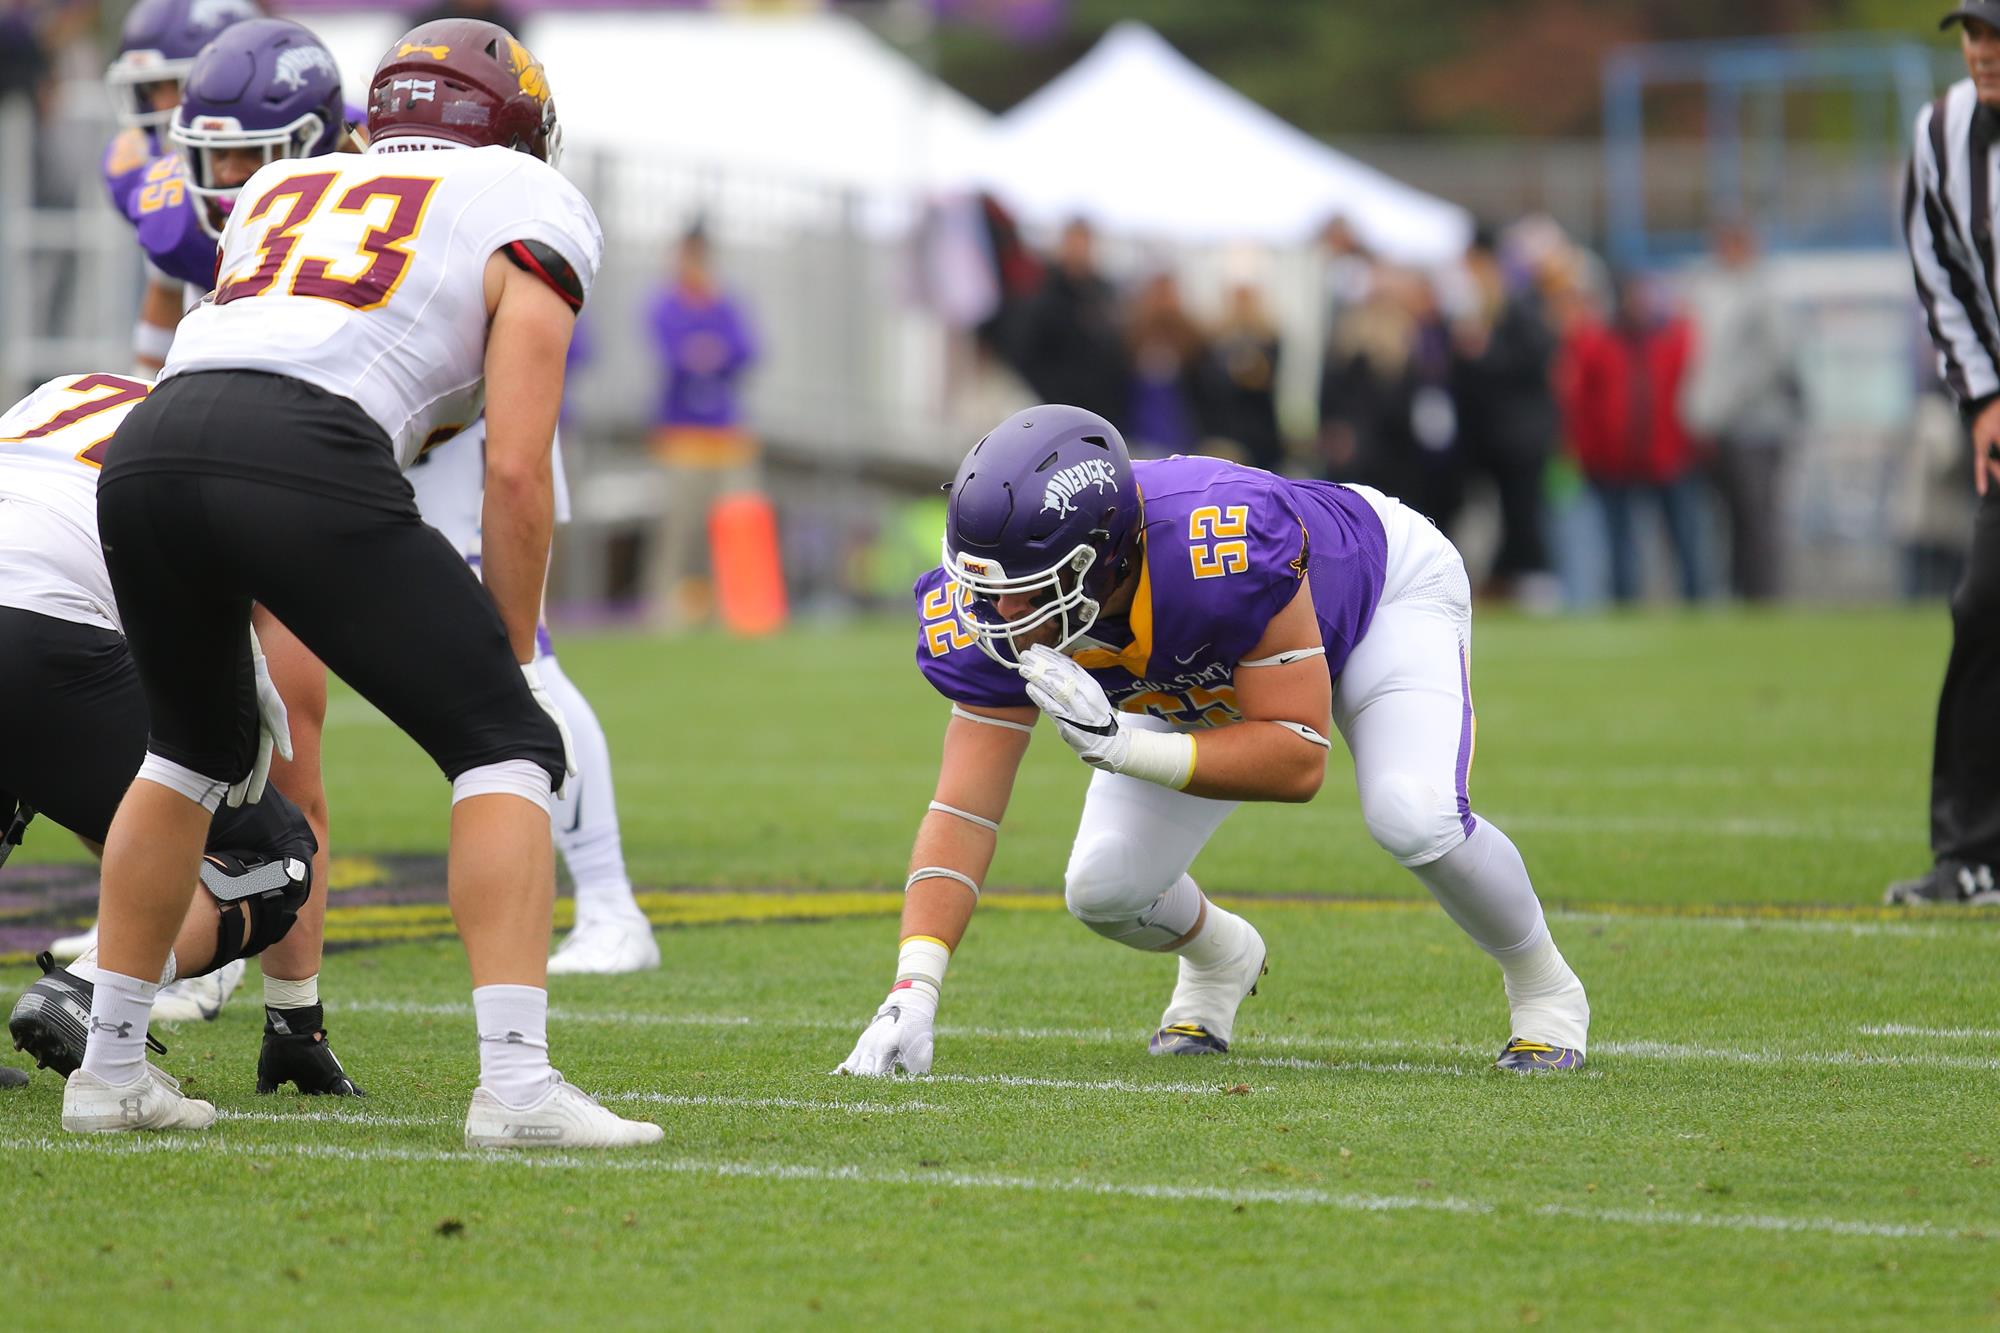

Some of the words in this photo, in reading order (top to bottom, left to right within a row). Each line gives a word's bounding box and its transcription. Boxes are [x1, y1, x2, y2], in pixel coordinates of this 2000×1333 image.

[214, 171, 443, 312] 33
[1188, 505, 1249, 579] 52
[923, 580, 979, 658] 52
